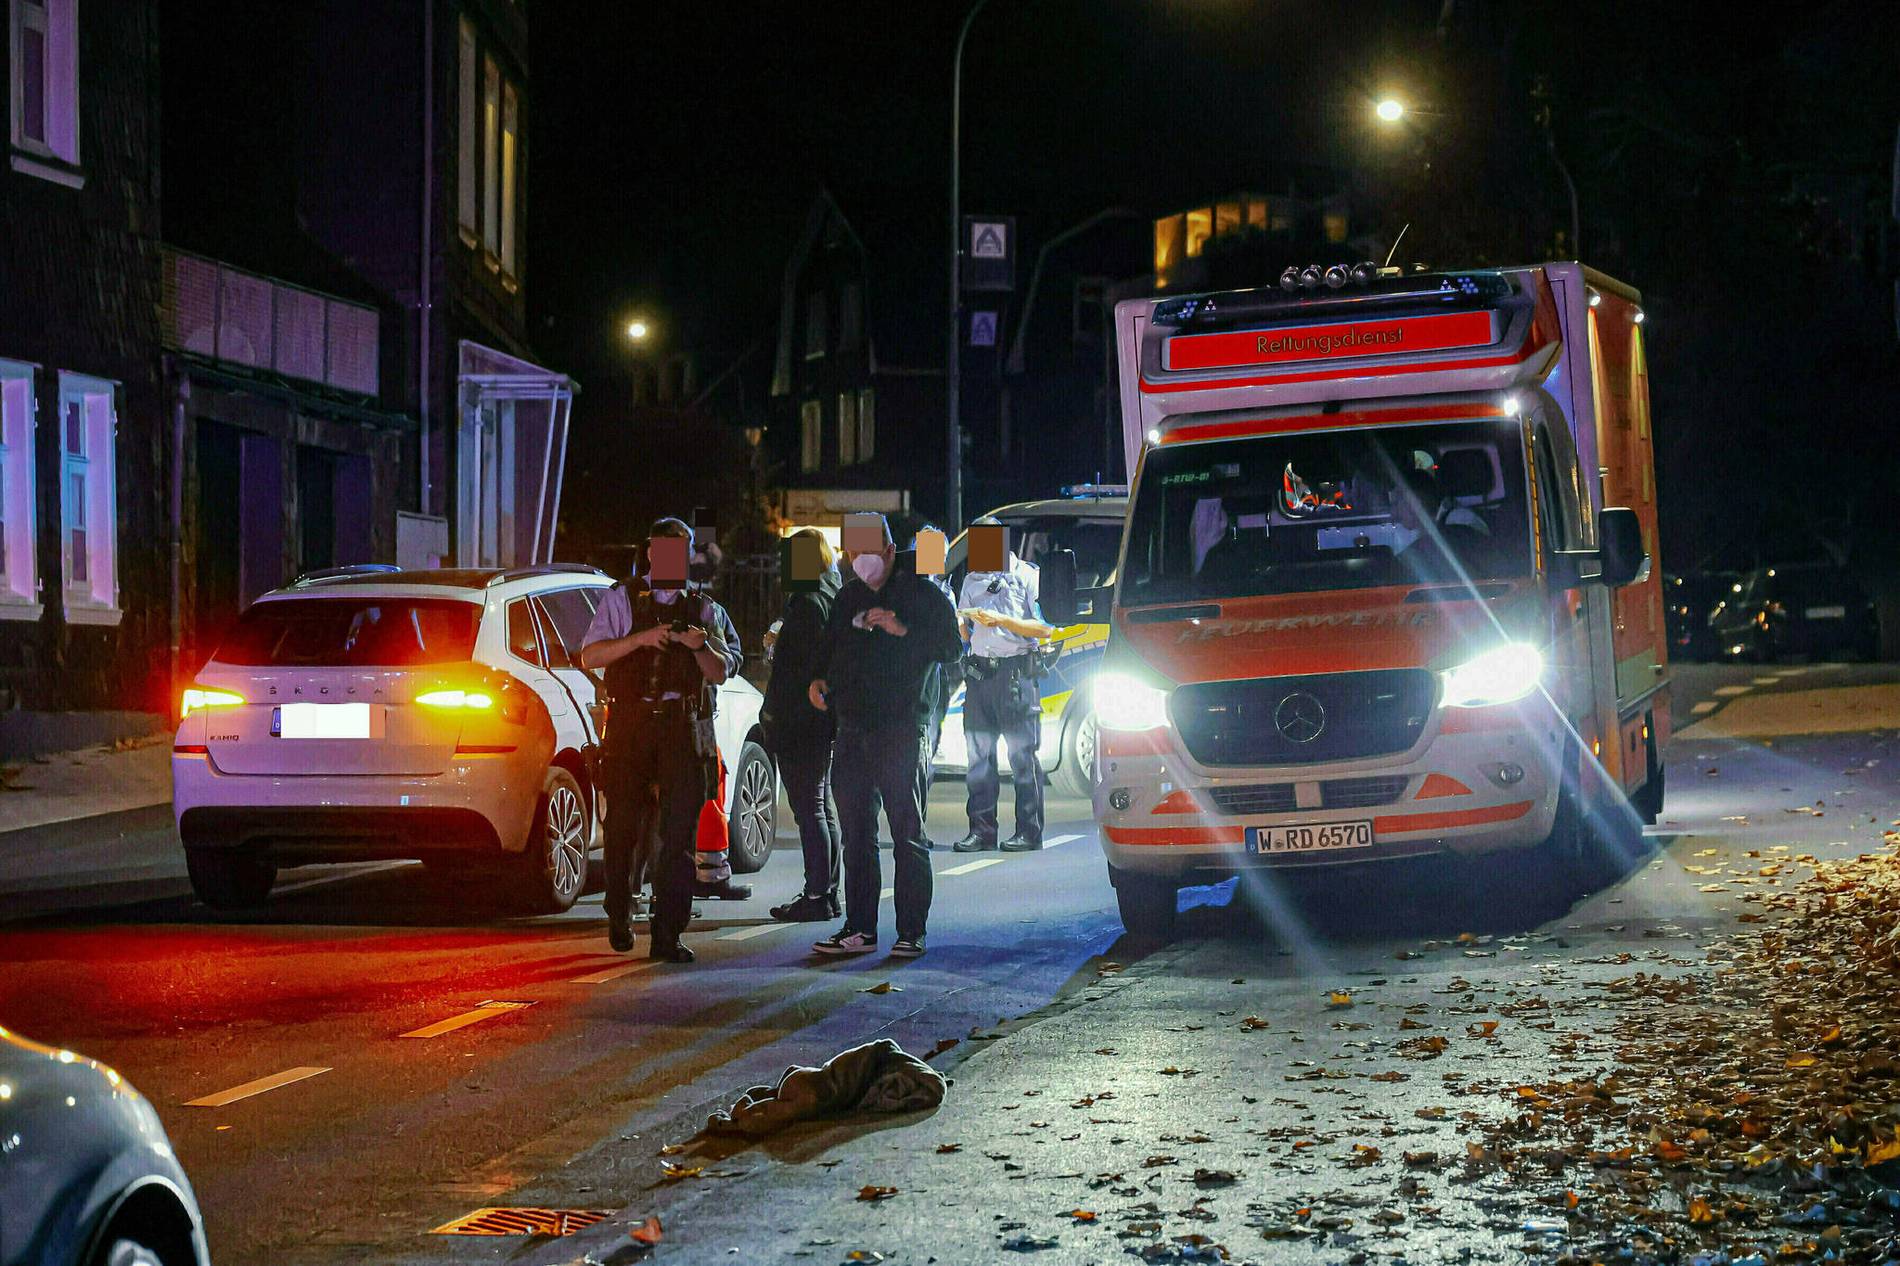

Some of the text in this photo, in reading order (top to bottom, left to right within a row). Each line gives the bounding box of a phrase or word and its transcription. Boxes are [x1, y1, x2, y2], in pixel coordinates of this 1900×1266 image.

[976, 226, 1002, 254] A
[1257, 327, 1403, 354] Rettungsdienst
[1259, 824, 1369, 851] W RD 6570
